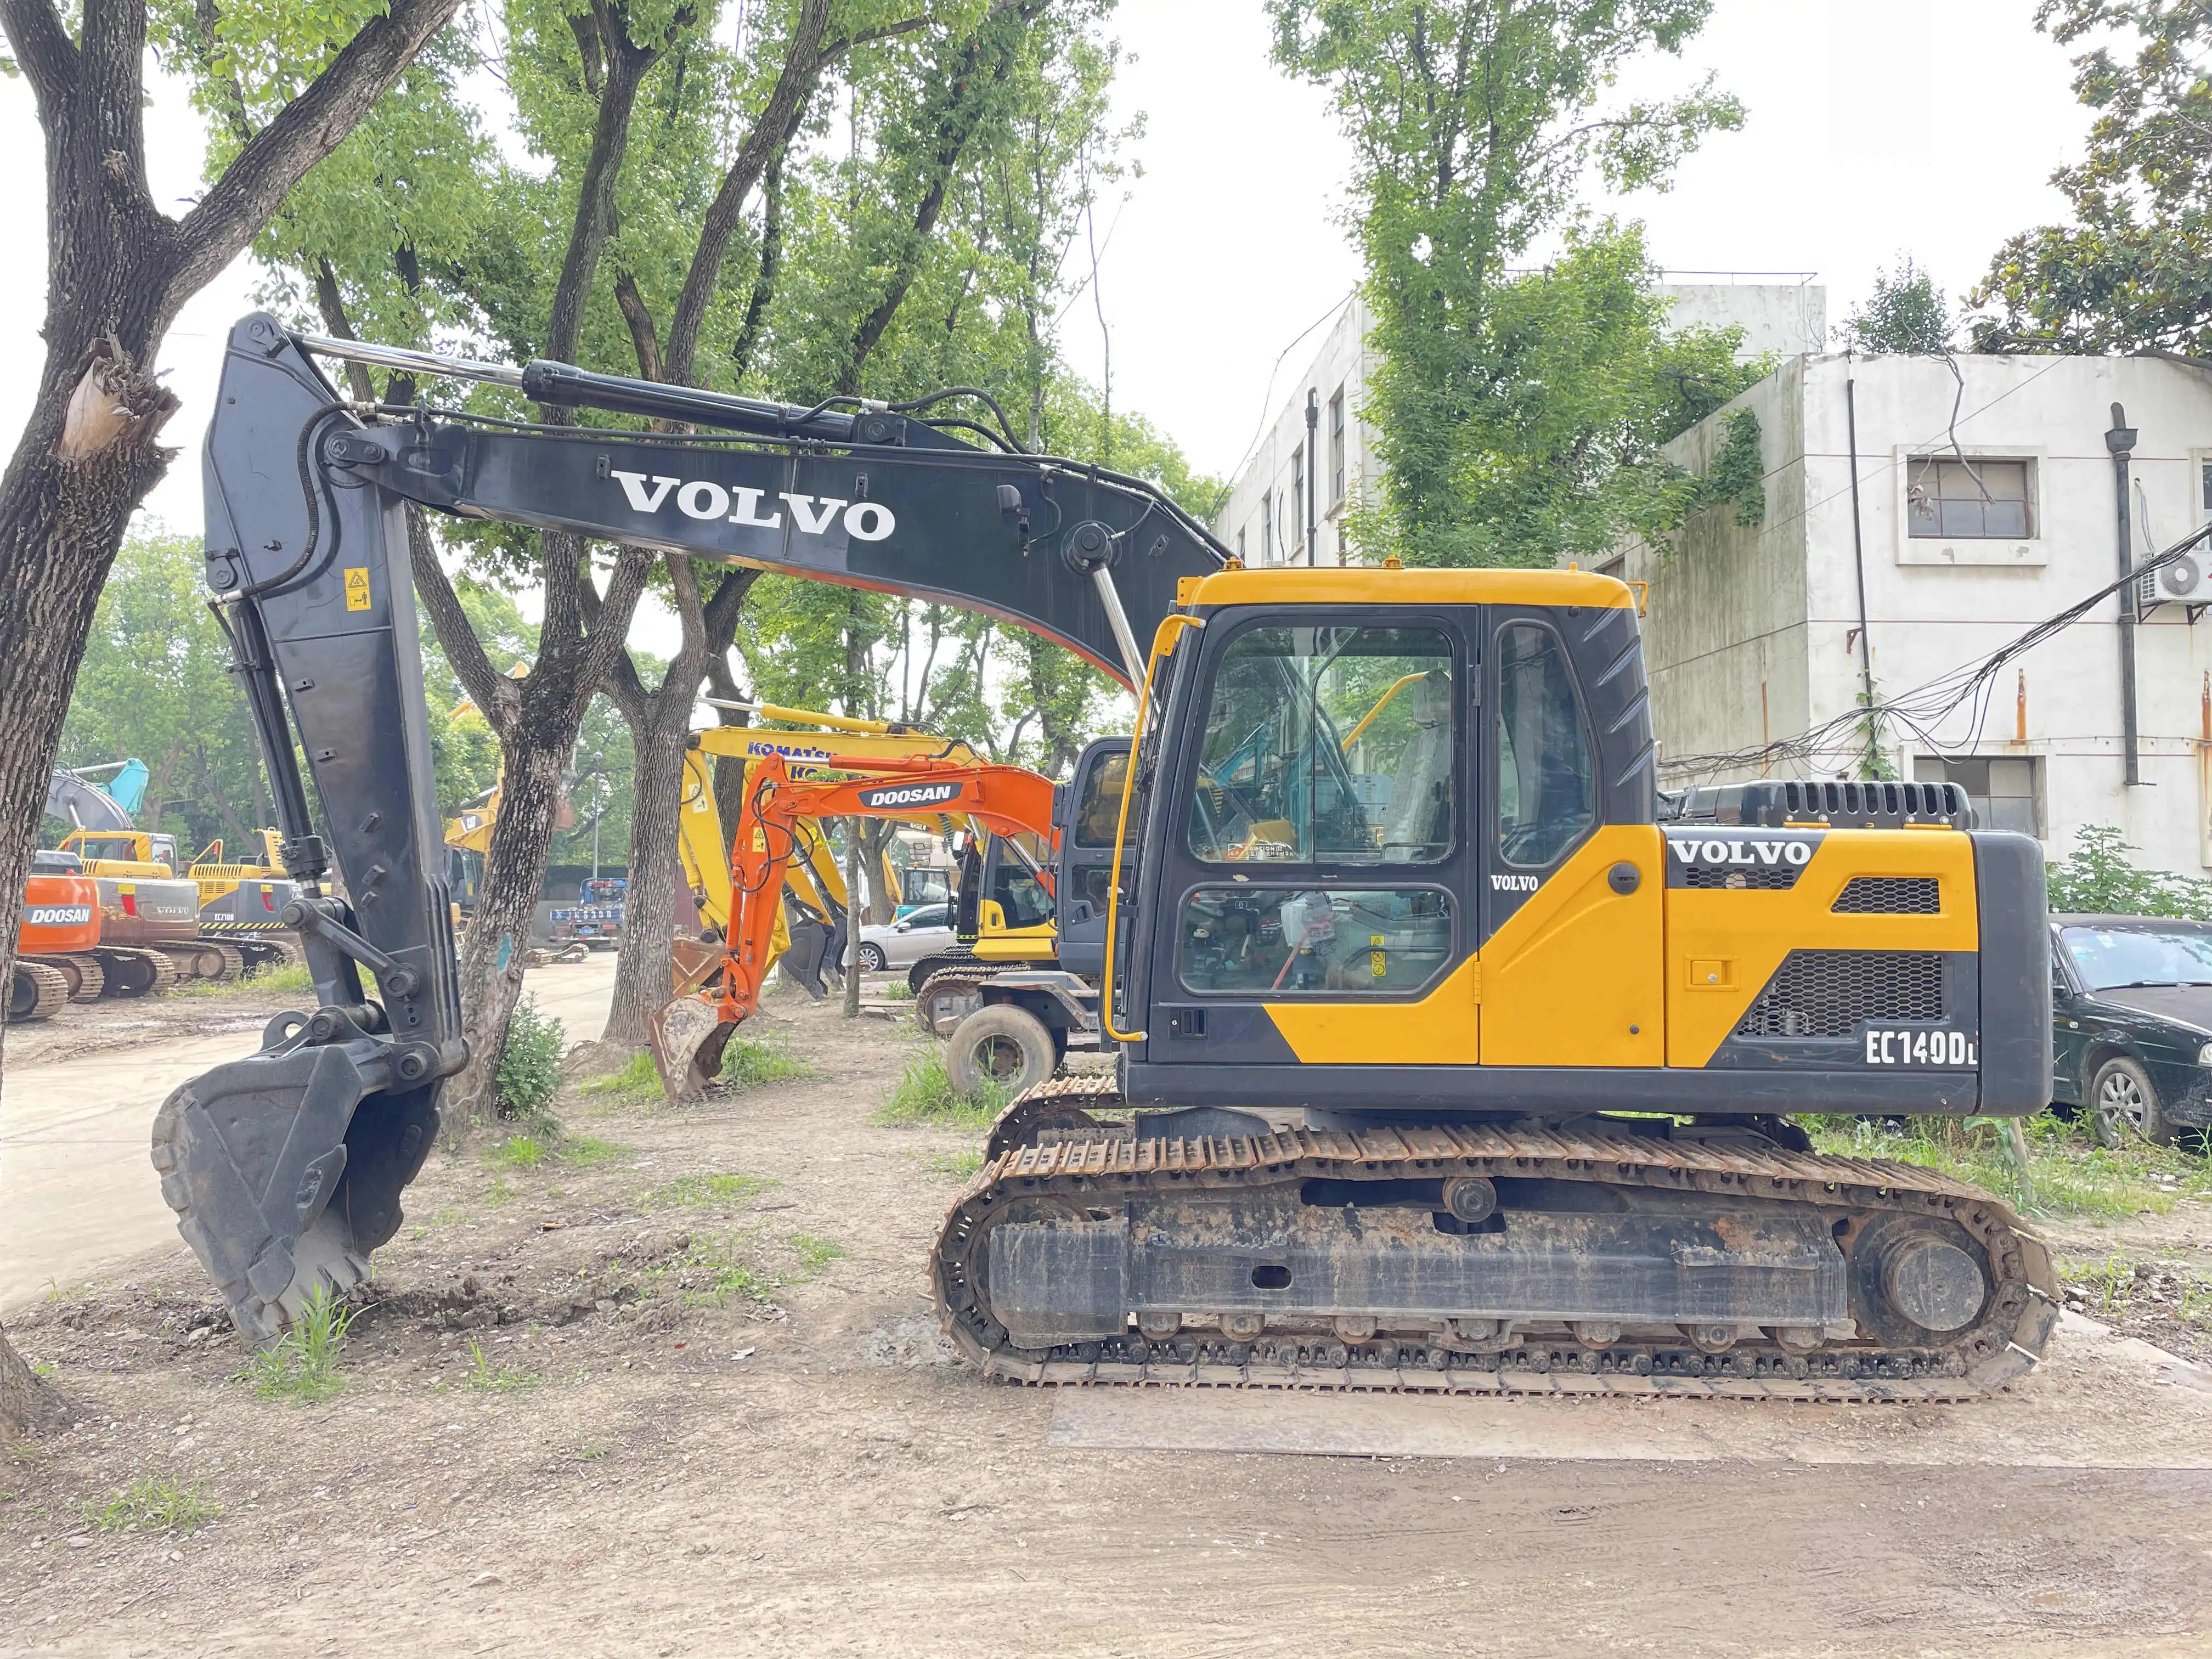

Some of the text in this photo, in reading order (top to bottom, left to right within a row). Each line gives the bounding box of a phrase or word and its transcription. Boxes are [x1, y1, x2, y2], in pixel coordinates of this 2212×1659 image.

[611, 470, 895, 541] VOLVO
[871, 786, 951, 806] DOOSAN
[1668, 840, 1811, 865] VOLVO
[1491, 875, 1538, 891] VOLVO
[31, 909, 89, 923] DOOSAN
